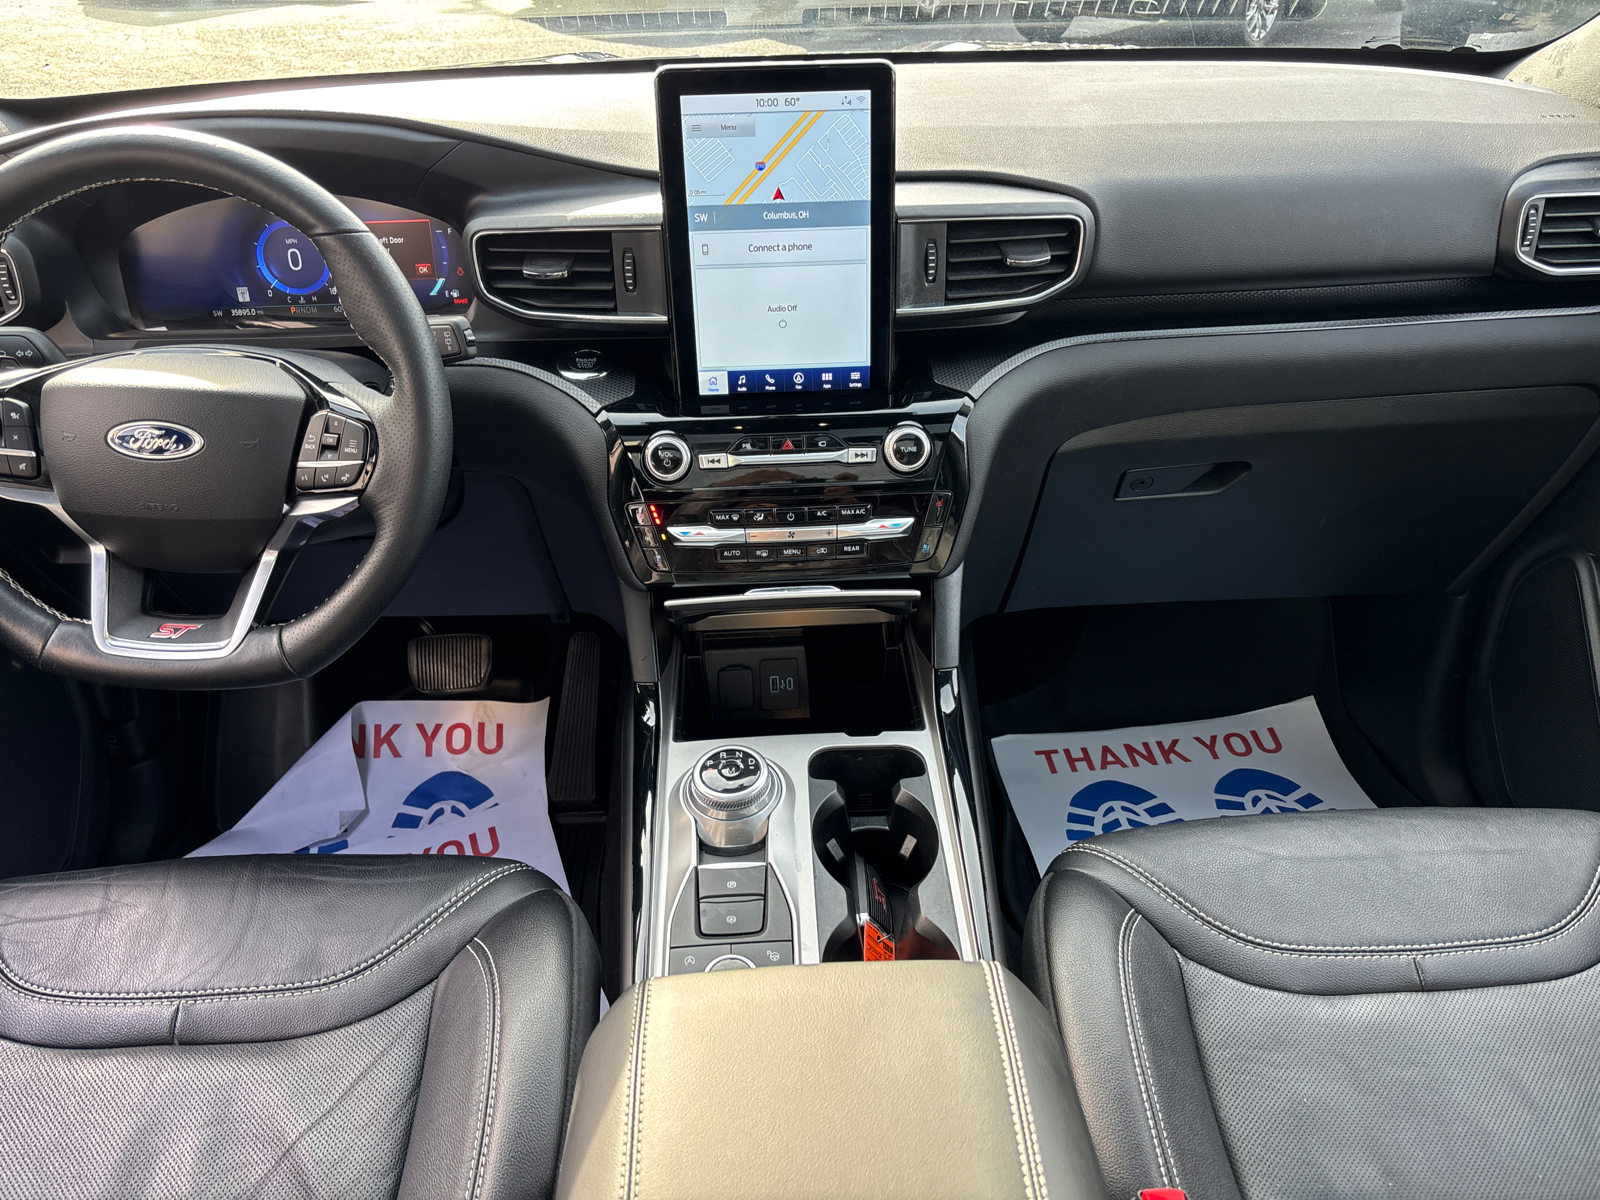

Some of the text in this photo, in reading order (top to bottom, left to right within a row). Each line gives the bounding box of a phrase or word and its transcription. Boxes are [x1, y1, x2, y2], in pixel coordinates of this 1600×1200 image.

[755, 97, 800, 108] 10:00 60°
[694, 213, 708, 223] SW
[763, 210, 810, 220] Columbus, OH
[389, 236, 404, 244] Door
[748, 242, 813, 253] Connect a phone
[287, 248, 303, 271] 0
[418, 266, 429, 274] OK
[267, 289, 273, 298] 0
[212, 309, 223, 317] SW
[767, 304, 798, 313] Audio Off
[129, 427, 185, 451] Ford
[149, 623, 204, 639] ST
[416, 722, 504, 758] YOU
[1034, 727, 1283, 774] THANK YOU
